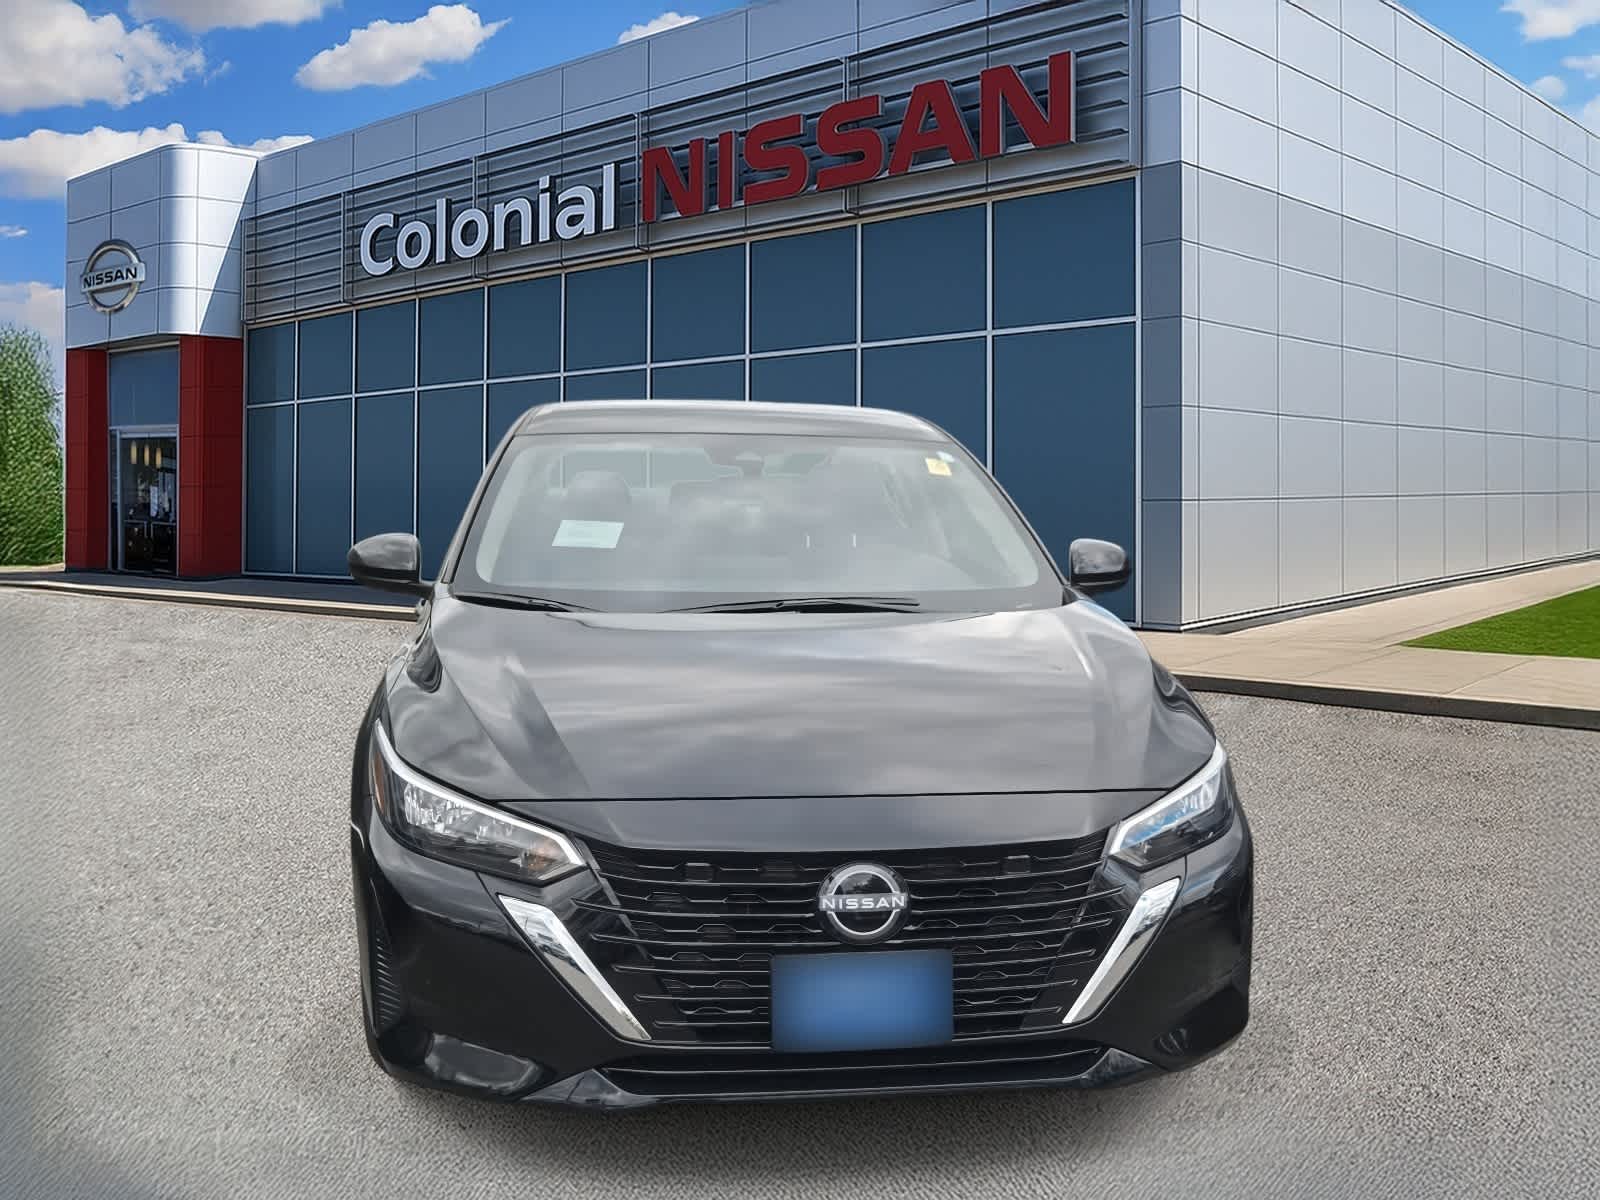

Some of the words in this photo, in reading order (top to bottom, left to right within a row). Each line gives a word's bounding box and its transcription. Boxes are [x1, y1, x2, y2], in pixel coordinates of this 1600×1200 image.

[359, 163, 616, 277] Colonial
[642, 50, 1077, 223] NISSAN
[83, 266, 137, 289] NISSAN
[821, 895, 905, 910] NISSAN
